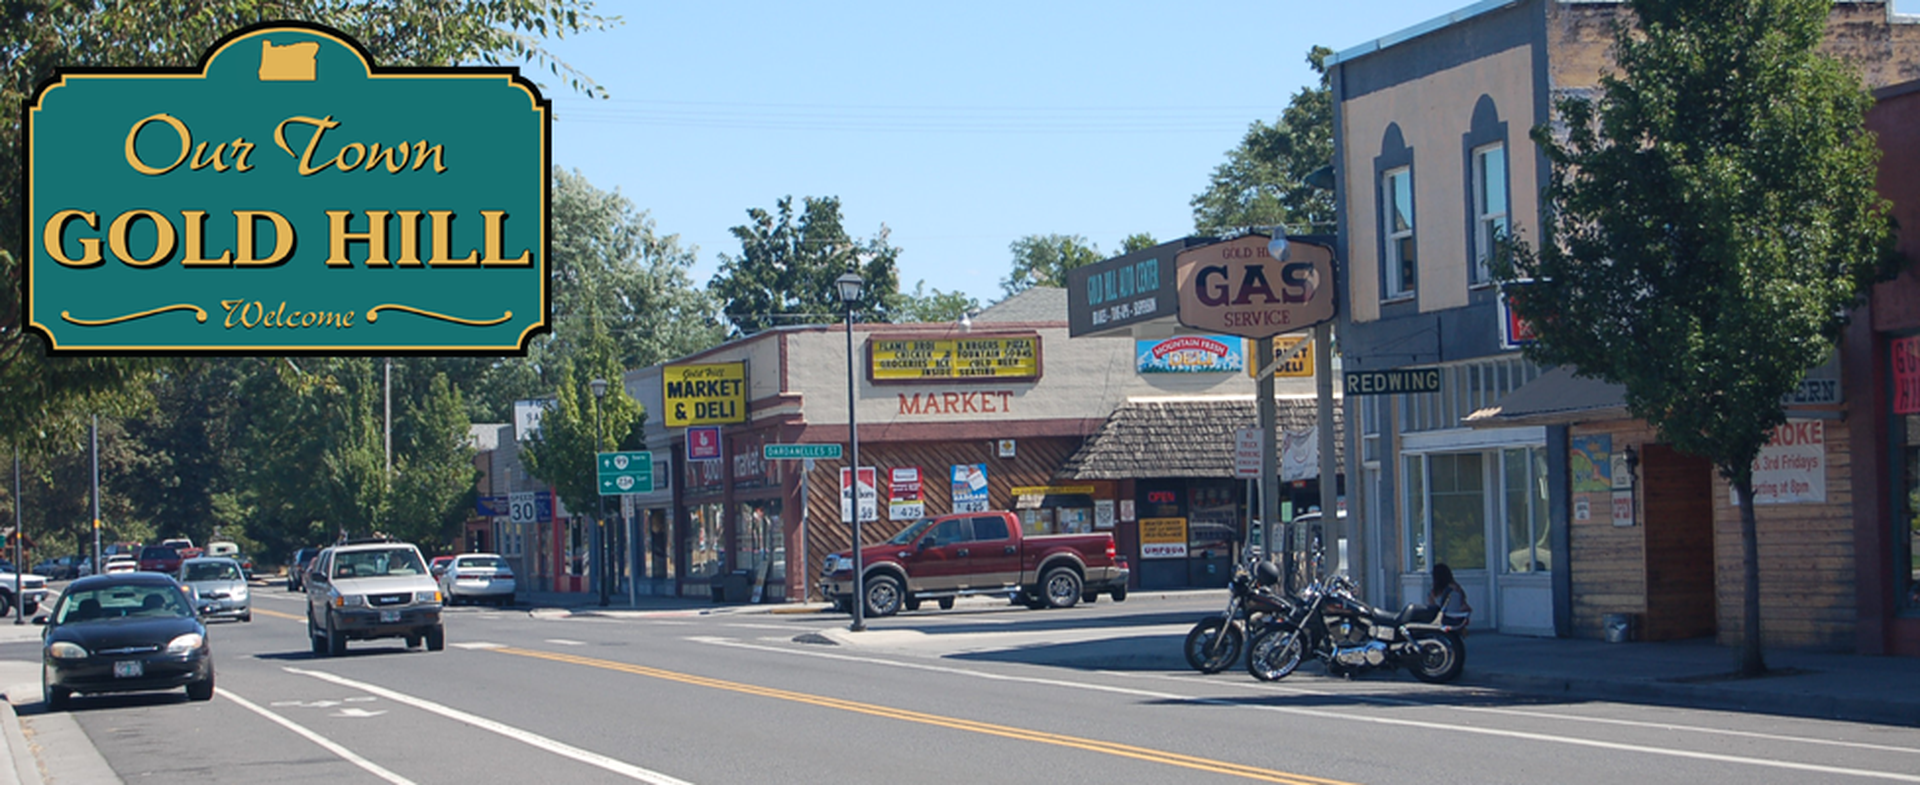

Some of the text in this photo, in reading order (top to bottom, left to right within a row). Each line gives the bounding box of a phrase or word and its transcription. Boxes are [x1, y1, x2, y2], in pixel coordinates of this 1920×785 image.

[1223, 247, 1253, 260] GOLD
[1136, 258, 1159, 294] CENTER
[1195, 262, 1318, 307] GAS
[1224, 309, 1290, 328] SERVICE
[1155, 339, 1225, 355] MOUNTAIN FRESH
[1169, 350, 1213, 367] DELI
[667, 379, 742, 398] MARKET
[1347, 370, 1438, 393] REDWING
[1783, 381, 1835, 402] ERN
[675, 400, 735, 419] & DELI
[897, 390, 1014, 415] MARKET
[1764, 421, 1822, 447] AOKE
[768, 446, 825, 457] DARDANELLES
[1763, 455, 1779, 470] 3rd
[1782, 454, 1819, 472] Fridays
[1148, 491, 1175, 502] OPEN
[512, 502, 533, 520] 30
[1144, 546, 1184, 554] UMPQUA
